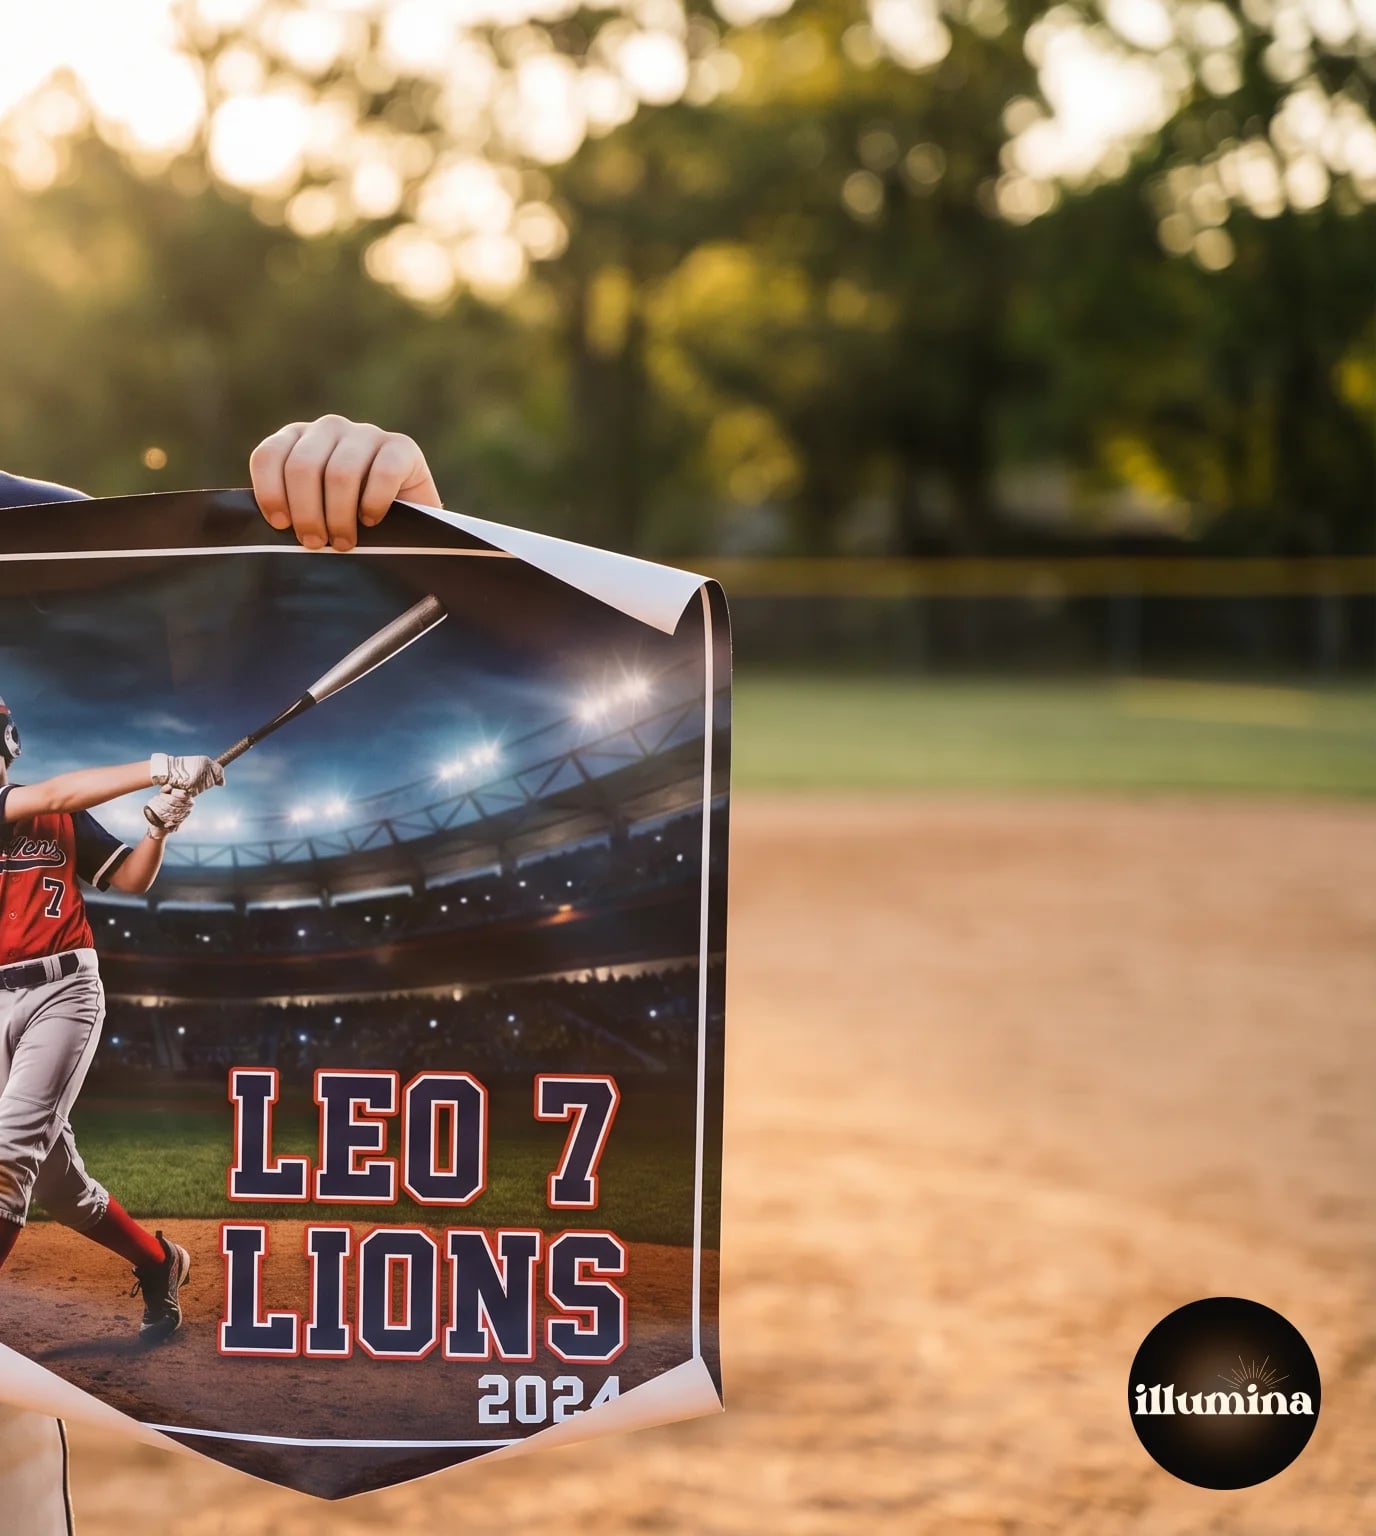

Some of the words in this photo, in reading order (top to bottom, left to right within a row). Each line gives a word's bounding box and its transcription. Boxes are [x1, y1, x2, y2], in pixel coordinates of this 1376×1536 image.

[42, 876, 66, 919] 7
[228, 1066, 488, 1206] LEO
[534, 1073, 621, 1210] 7
[217, 1222, 629, 1364] LIONS
